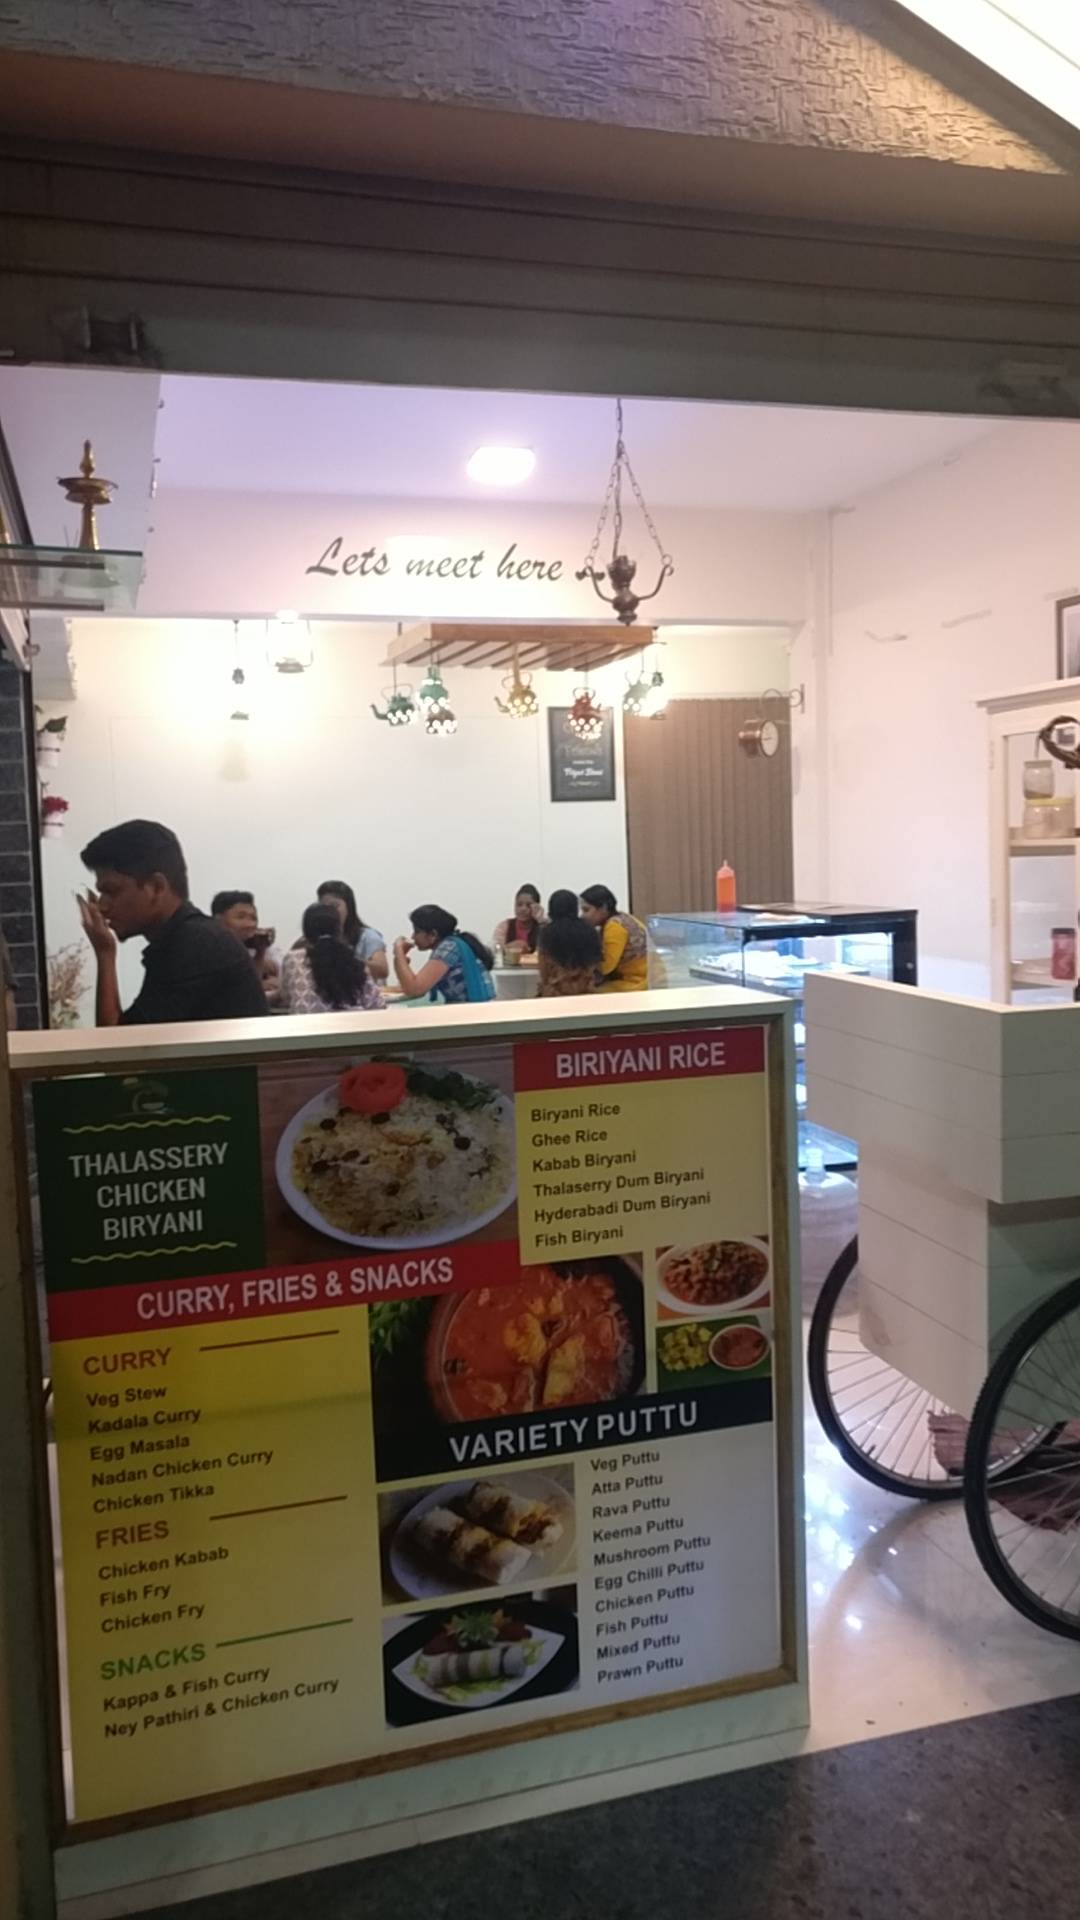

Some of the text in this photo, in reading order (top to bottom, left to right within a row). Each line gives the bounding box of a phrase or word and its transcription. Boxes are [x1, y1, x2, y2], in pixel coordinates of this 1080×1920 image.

[305, 536, 563, 581] Lets meet here
[556, 1042, 725, 1078] BIRIYANI RICE
[531, 1104, 620, 1123] Biryani Rice
[532, 1130, 607, 1147] Ghee Rice
[69, 1142, 228, 1178] THALASSERY
[533, 1150, 636, 1172] Kabab Biryani
[97, 1177, 205, 1208] CHICKEN
[534, 1169, 704, 1197] Thalaserry Dum Biryani
[534, 1192, 710, 1225] Hyderabadi Dum Biryani
[103, 1210, 203, 1241] BIRYANI
[535, 1226, 623, 1248] Fish Biryani
[136, 1257, 453, 1320] CURRY, FRIES & SNACKS
[83, 1348, 172, 1376] CURRY
[87, 1386, 167, 1408] Veg Stew
[88, 1408, 201, 1434] Kadala Curry
[450, 1401, 698, 1463] VARIETY PUTTU
[90, 1435, 190, 1462] Egg Masala
[591, 1450, 660, 1472] Veg Puttu
[92, 1450, 273, 1487] Nadan Chicken Curry
[592, 1474, 663, 1495] Atta Puttu
[93, 1484, 214, 1514] Chicken Tikka
[593, 1496, 670, 1519] Rava Puttu
[96, 1520, 170, 1549] FRIES
[593, 1516, 684, 1542] Keema Puttu
[98, 1546, 229, 1580] Chicken Kabab
[594, 1535, 711, 1566] Mushroom Puttu
[595, 1560, 704, 1591] Egg Chilli Puttu
[100, 1584, 171, 1607] Fish Fry
[595, 1585, 694, 1613] Chicken Puttu
[102, 1604, 205, 1633] Chicken Fry
[596, 1613, 668, 1636] Fish Puttu
[597, 1634, 680, 1660] Mixed Puttu
[100, 1643, 206, 1680] SNACKS
[598, 1656, 683, 1683] Prawn Puttu
[104, 1666, 270, 1713] Kappa & Fish Curry
[104, 1678, 339, 1738] Ney Pathiri & Chicken Curry
